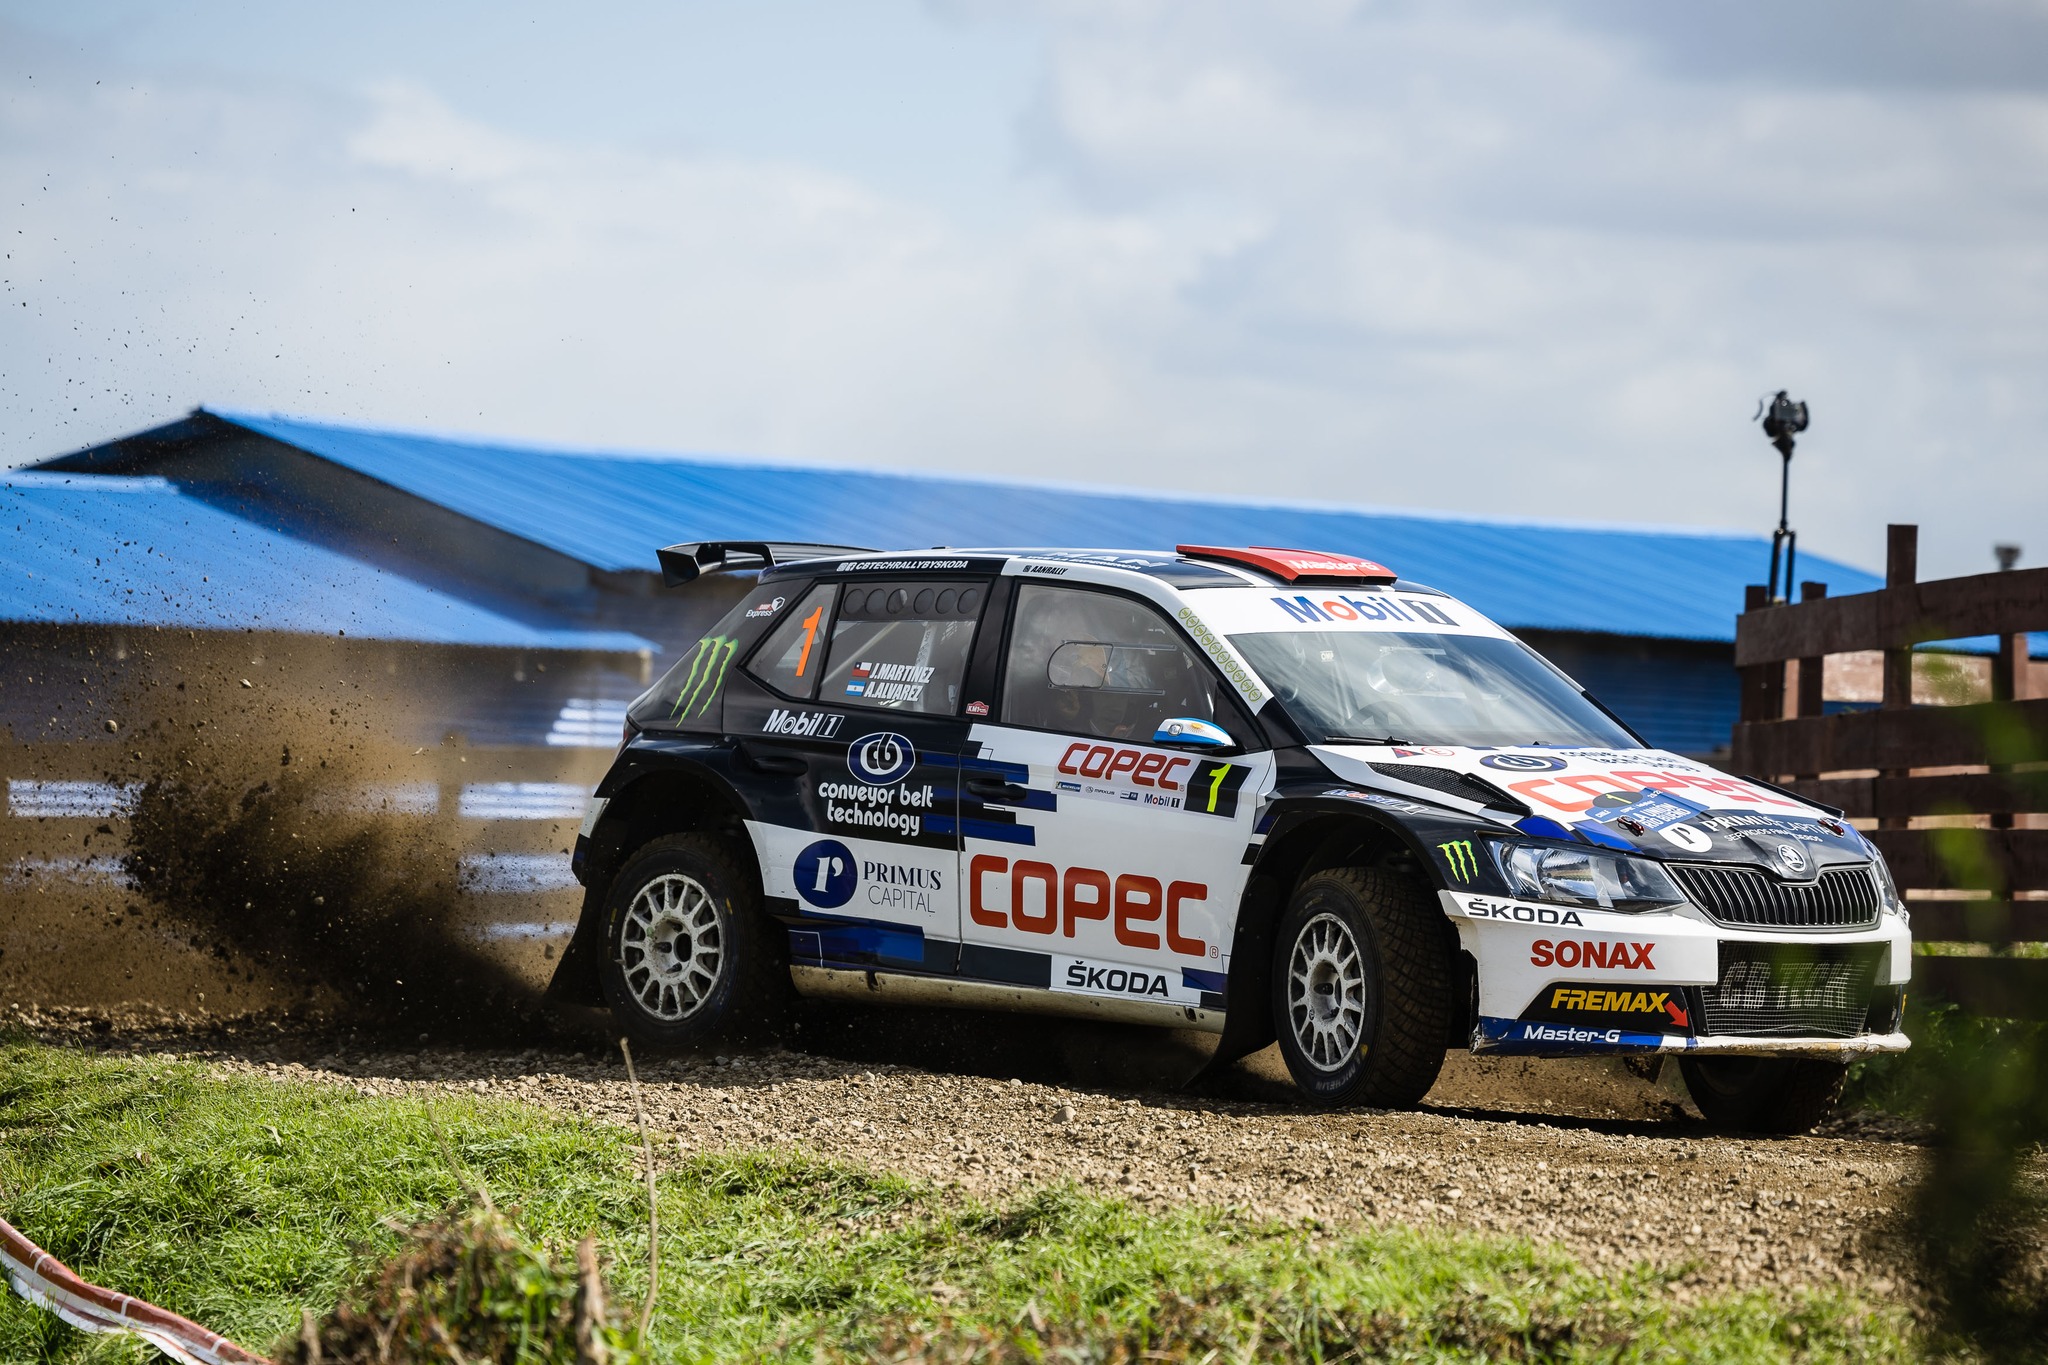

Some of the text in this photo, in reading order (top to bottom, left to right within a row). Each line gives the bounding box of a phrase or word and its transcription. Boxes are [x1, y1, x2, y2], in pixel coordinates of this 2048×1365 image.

[1270, 595, 1415, 623] Mobil
[795, 606, 823, 677] 1
[869, 663, 935, 683] J.MARTINEZ
[864, 681, 923, 702] A.ALVAREZ
[762, 709, 824, 736] Mobil
[818, 782, 934, 808] conveyor belt
[1144, 793, 1170, 807] Mobil
[1206, 763, 1233, 813] 1
[1605, 793, 1632, 804] 1
[827, 799, 921, 836] technology
[863, 860, 942, 891] PRIMUS
[868, 885, 936, 914] CAPITAL
[1468, 898, 1584, 927] ŠKODA
[1530, 939, 1656, 970] SONAX
[1066, 960, 1169, 997] ŠKODA
[1550, 988, 1670, 1013] FREMAX
[1523, 1024, 1622, 1043] Master-G
